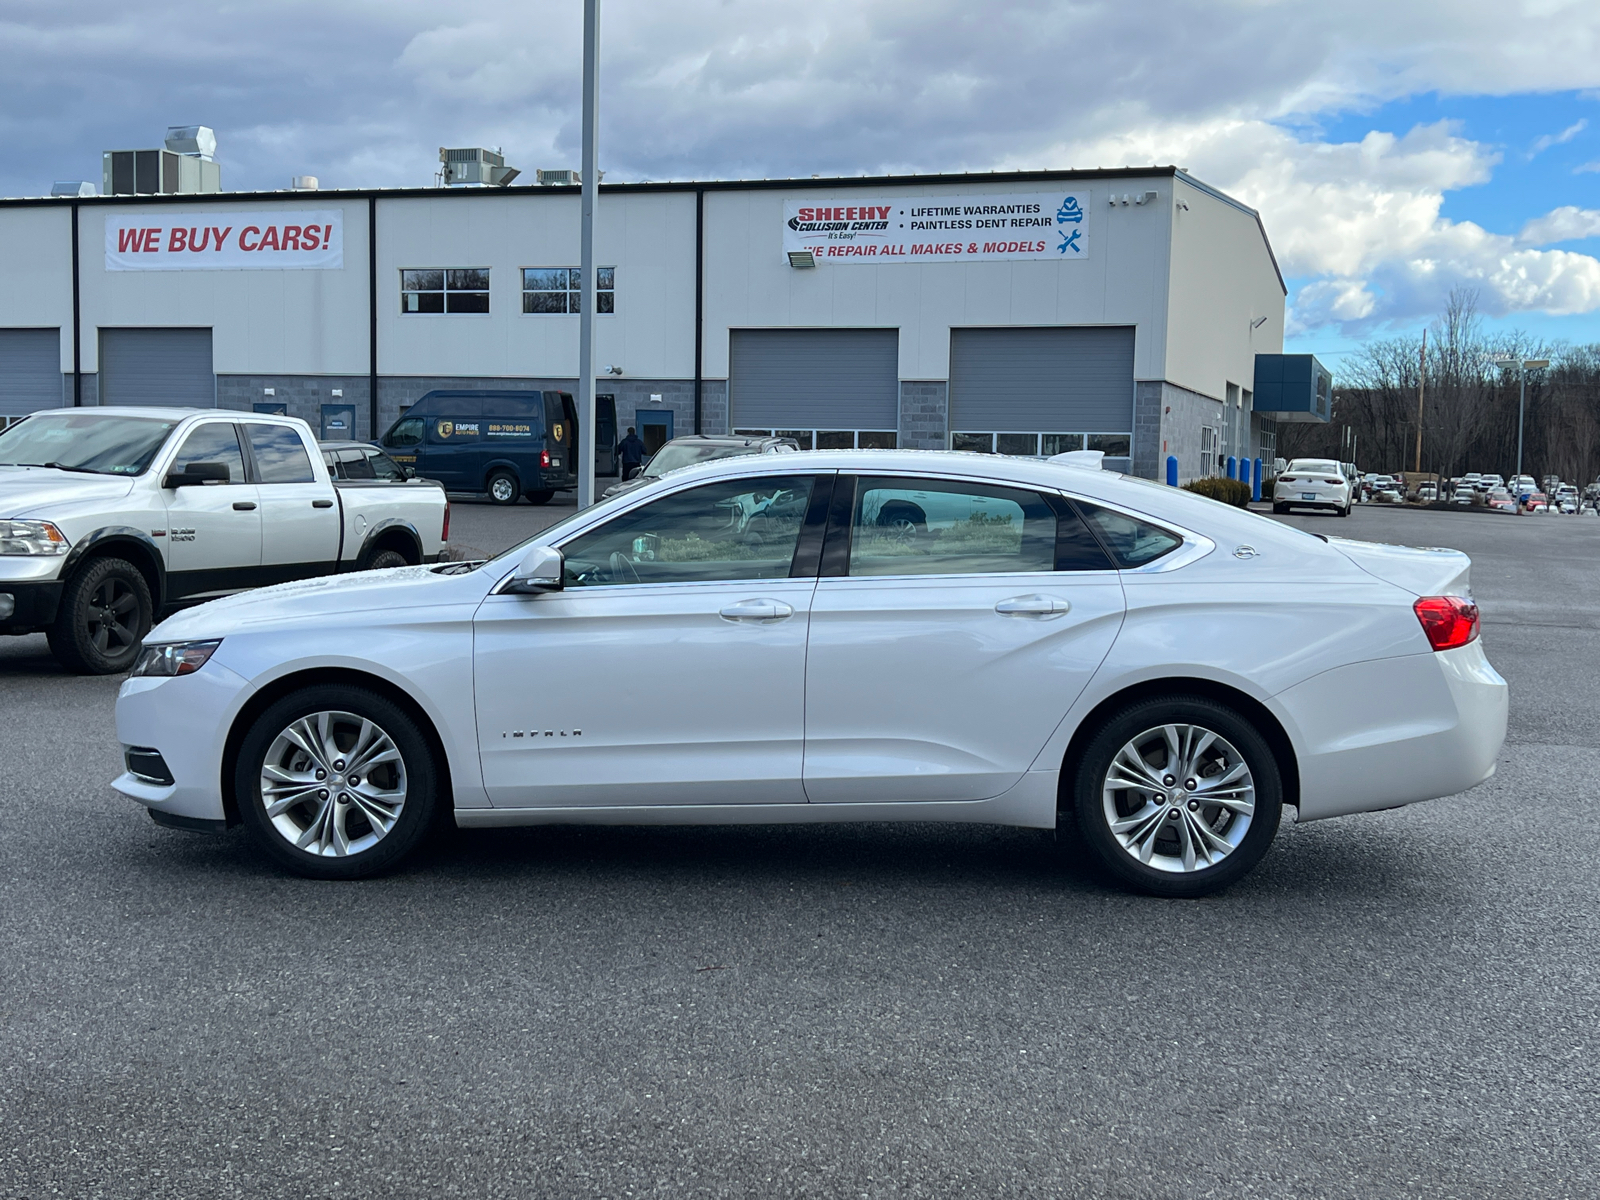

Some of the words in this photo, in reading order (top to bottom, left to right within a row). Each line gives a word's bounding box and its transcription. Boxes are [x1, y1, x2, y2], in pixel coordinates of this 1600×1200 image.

[798, 206, 892, 221] SHEEHY
[911, 206, 961, 217] LIFETIME
[963, 204, 1041, 215] WARRANTIES
[799, 222, 850, 231] COLLISION
[851, 221, 889, 231] CENTER
[911, 220, 972, 230] PAINTLESS
[975, 218, 1008, 229] DENT
[1010, 217, 1052, 228] REPAIR
[118, 228, 162, 253] WE
[168, 227, 233, 252] BUY
[238, 224, 333, 251] CARS!
[828, 232, 838, 240] It's
[839, 231, 857, 240] Easy!
[827, 245, 878, 257] REPAIR
[879, 244, 906, 256] ALL
[910, 243, 963, 255] MAKES
[966, 242, 979, 254] &
[982, 240, 1046, 254] MODELS
[455, 423, 479, 431] EMPIRE
[502, 728, 582, 738] IMPALA
